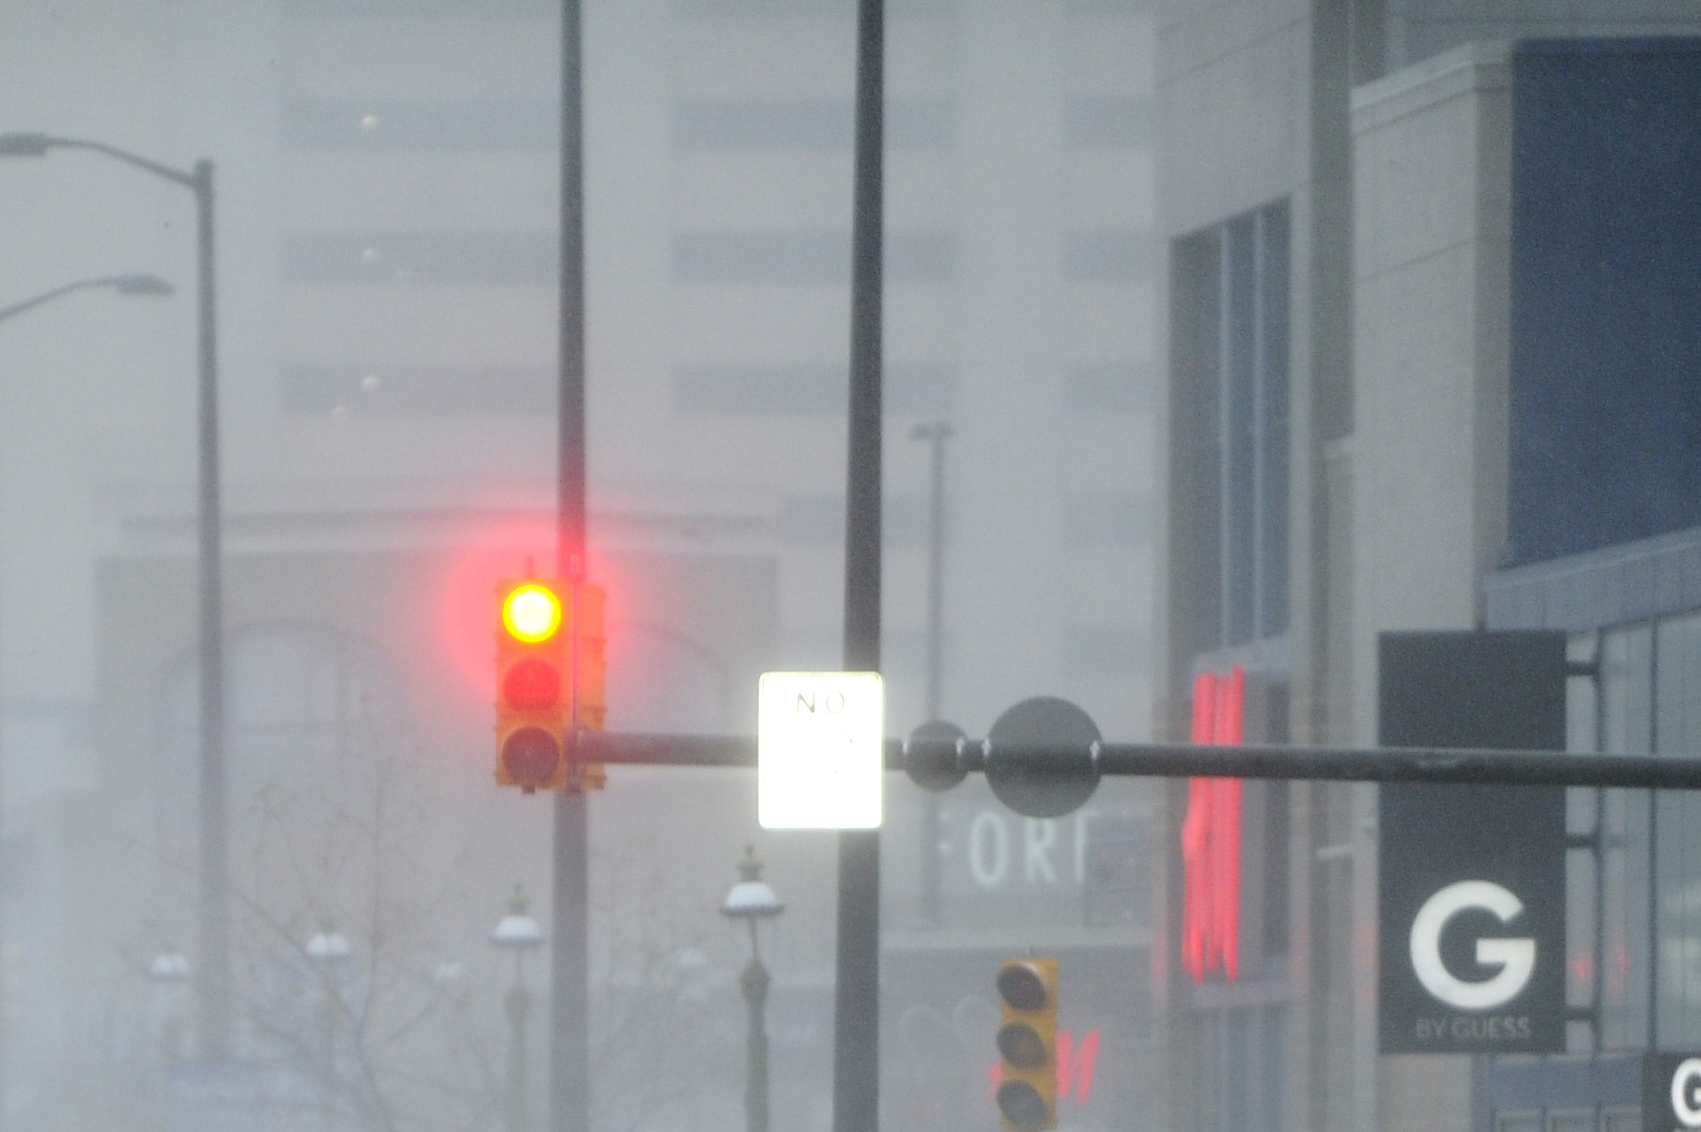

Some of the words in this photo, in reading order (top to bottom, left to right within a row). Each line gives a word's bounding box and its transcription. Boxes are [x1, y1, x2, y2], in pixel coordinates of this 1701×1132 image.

[796, 690, 846, 714] NO
[1409, 880, 1536, 1010] G
[1415, 1017, 1446, 1039] BY
[1451, 1016, 1531, 1039] GUESS
